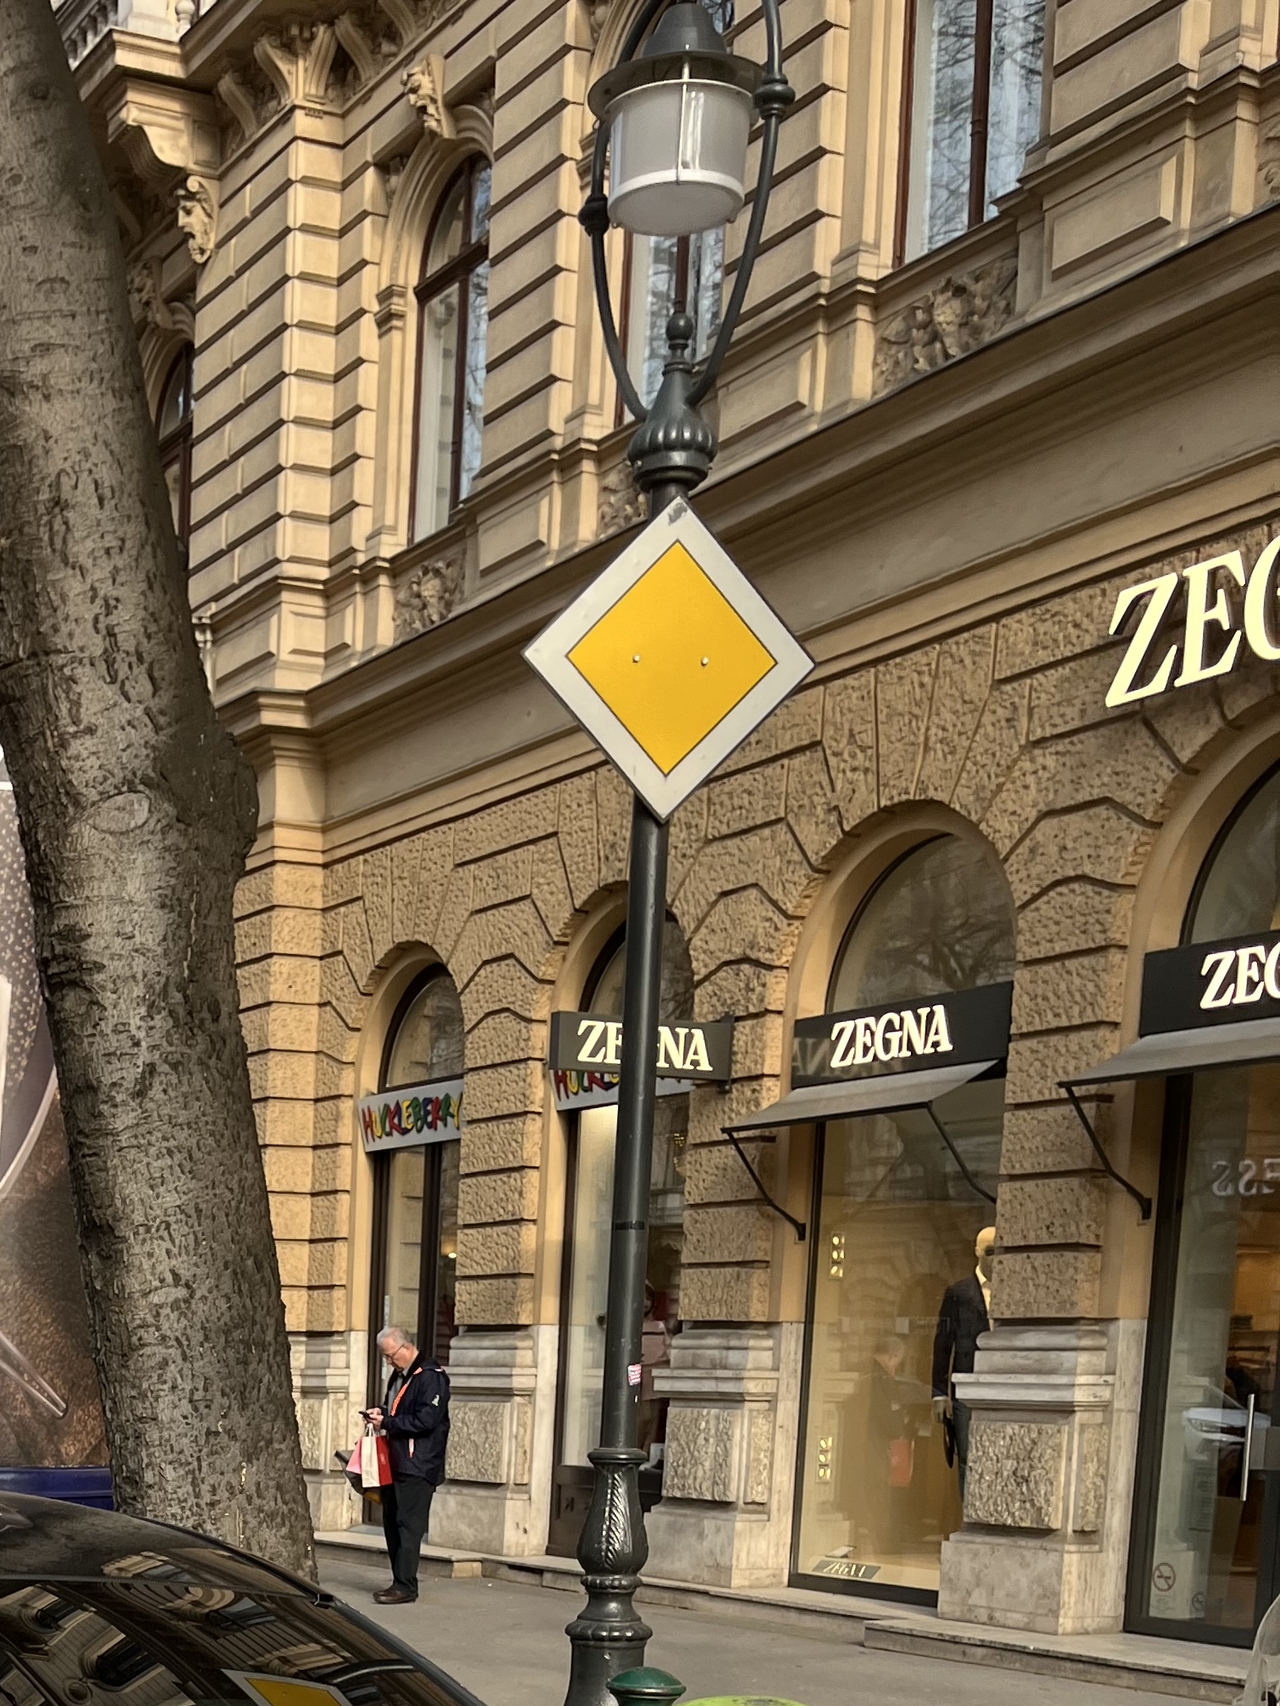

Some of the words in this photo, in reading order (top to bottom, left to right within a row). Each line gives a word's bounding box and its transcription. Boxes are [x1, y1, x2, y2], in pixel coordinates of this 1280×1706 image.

[577, 1020, 713, 1071] ZENA
[830, 1004, 953, 1069] ZEGNA
[361, 1091, 464, 1144] HUCKLEBERRY
